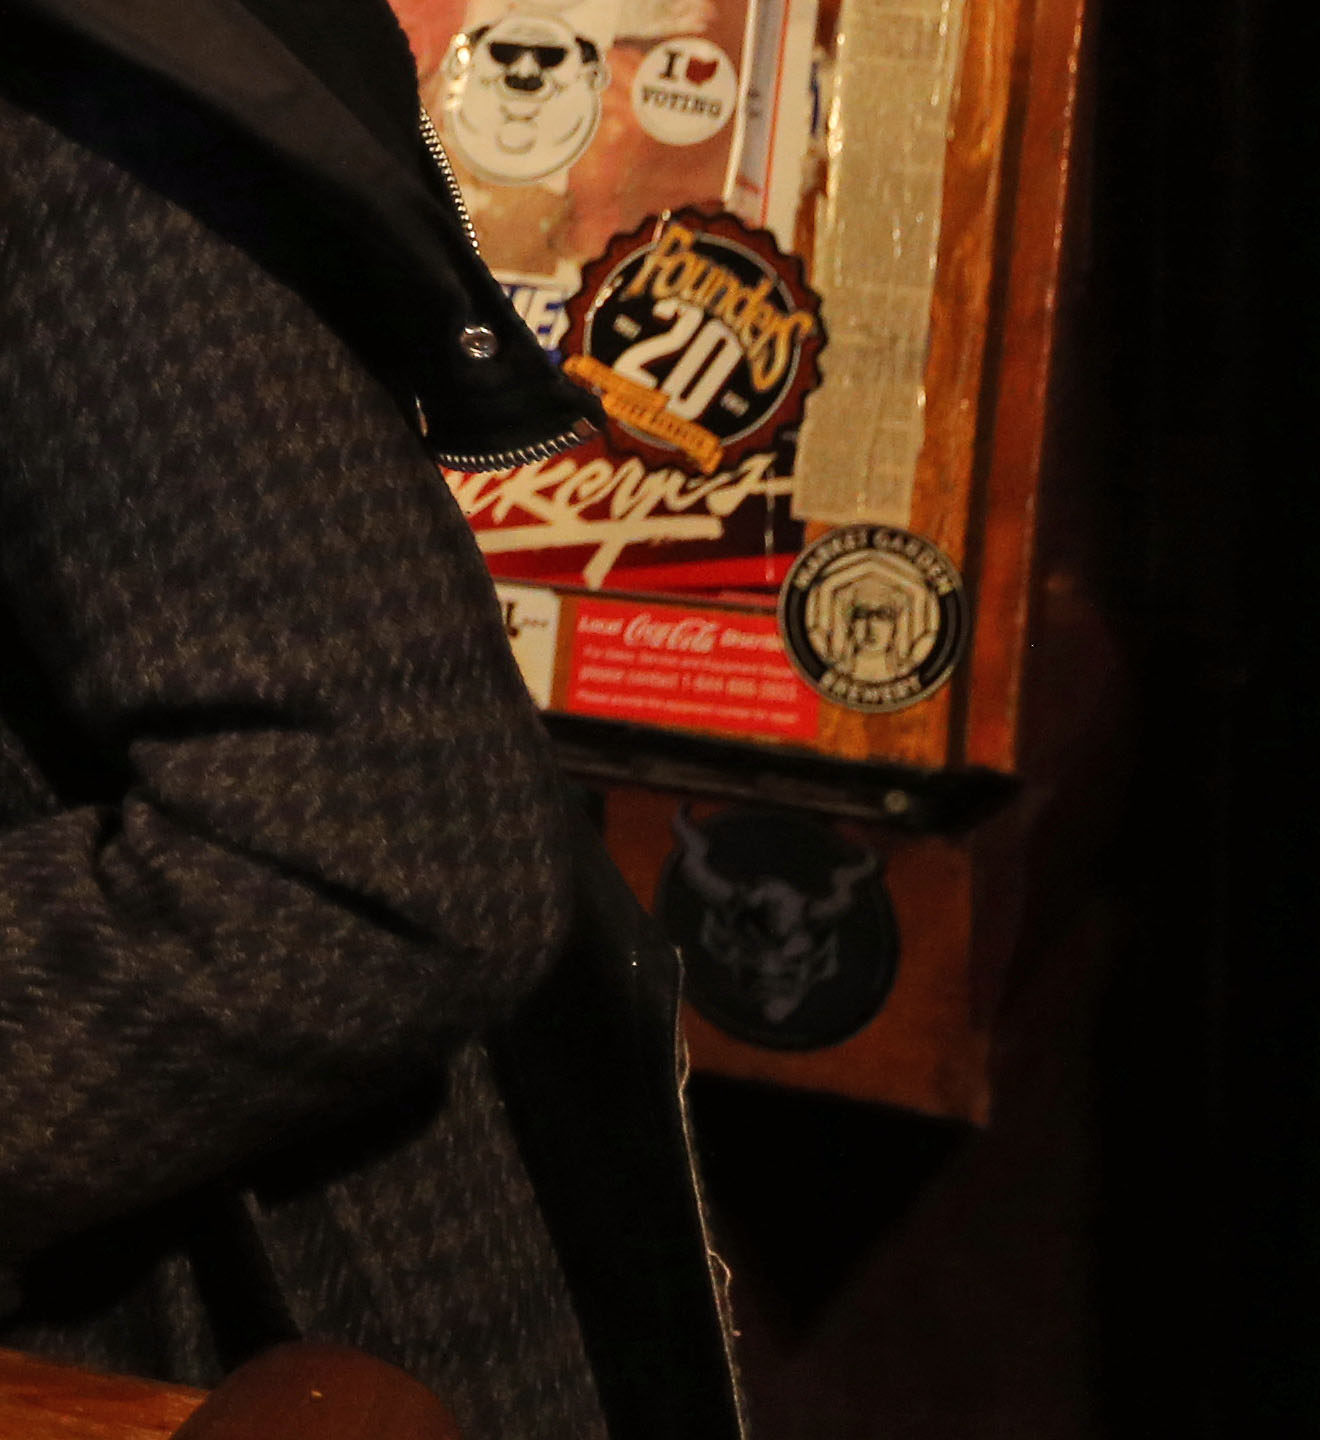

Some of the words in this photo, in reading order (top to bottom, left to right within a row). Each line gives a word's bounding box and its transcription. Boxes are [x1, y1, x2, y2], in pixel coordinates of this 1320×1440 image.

[641, 86, 723, 119] VOTING
[658, 49, 684, 81] I
[619, 224, 813, 393] Founders
[612, 296, 745, 421] 20
